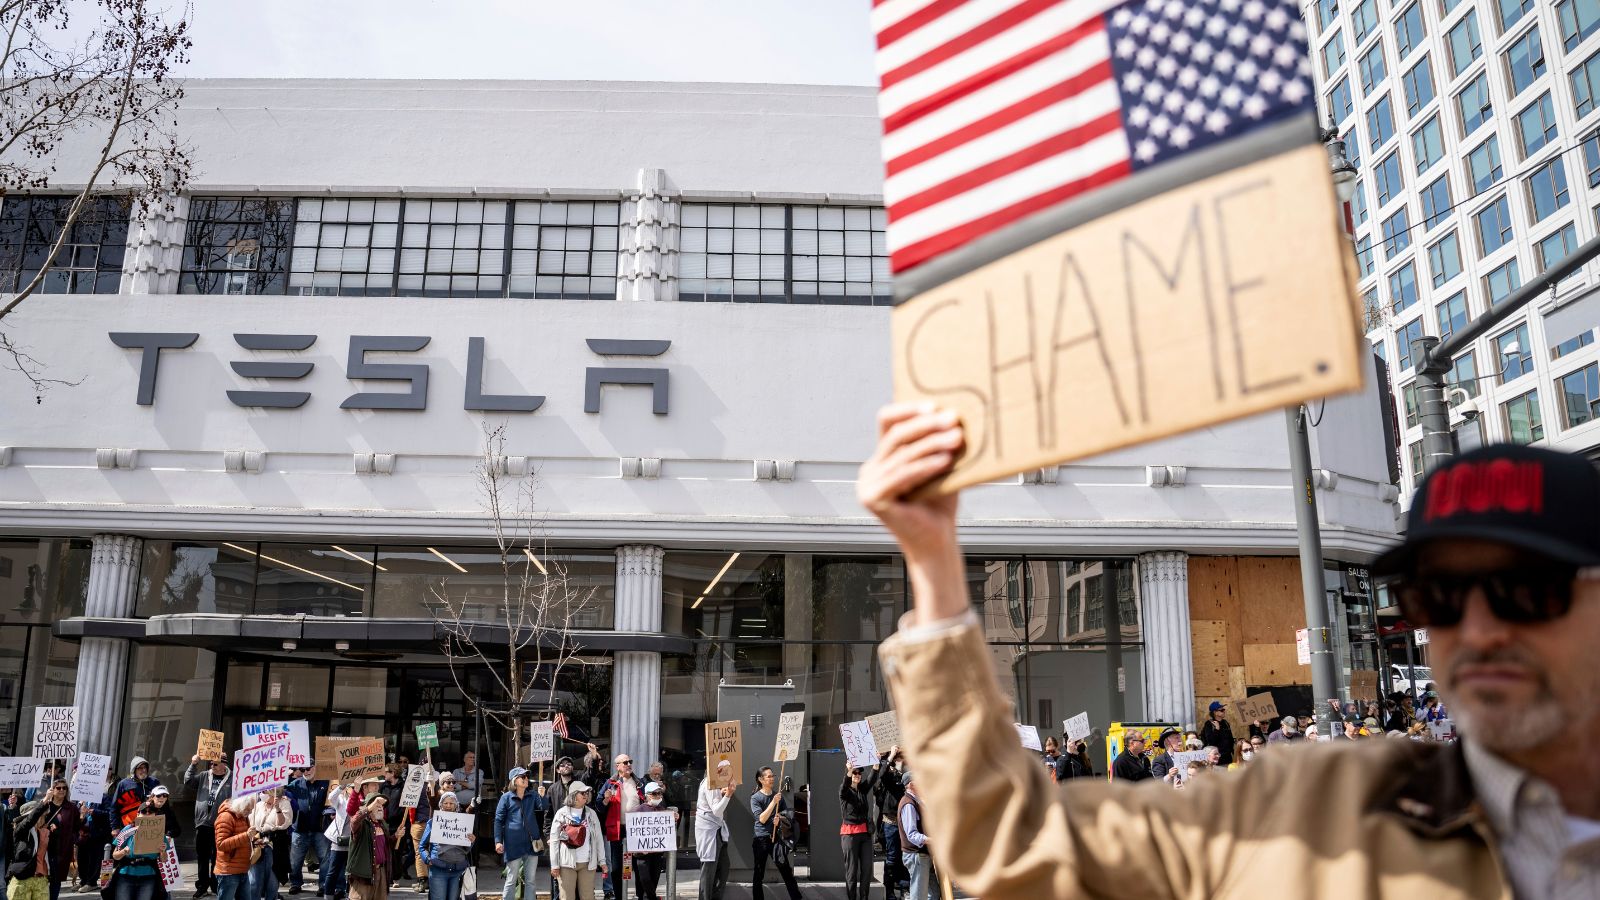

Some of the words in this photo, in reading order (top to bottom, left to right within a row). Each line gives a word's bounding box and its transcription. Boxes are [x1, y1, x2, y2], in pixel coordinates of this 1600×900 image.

[905, 177, 1331, 472] SHAME.
[108, 331, 672, 415] TESLA
[1348, 567, 1368, 578] SALES
[42, 708, 74, 720] MUSK
[781, 714, 800, 724] DUMP
[40, 721, 75, 732] TRUMP
[246, 724, 280, 736] UNITE
[783, 723, 801, 731] TRUMP
[37, 731, 75, 743] CROOKS
[258, 732, 289, 743] RESIST
[534, 733, 549, 741] SAVE
[713, 726, 737, 740] FLUSH
[777, 733, 792, 743] STOP
[203, 740, 221, 748] VOTED
[534, 741, 551, 750] CIVIL
[712, 740, 737, 755] MUSK
[35, 743, 77, 759] TRAITORS
[339, 746, 360, 758] YOUR
[360, 742, 383, 754] RIGHTS
[532, 749, 552, 759] SERVICE
[242, 744, 286, 768] POWER
[261, 760, 273, 769] THE
[243, 765, 287, 789] PEOPLE
[341, 766, 367, 780] FIGHT
[632, 815, 671, 826] IMPEACH
[630, 826, 673, 837] PRESIDENT
[637, 837, 666, 850] MUSK
